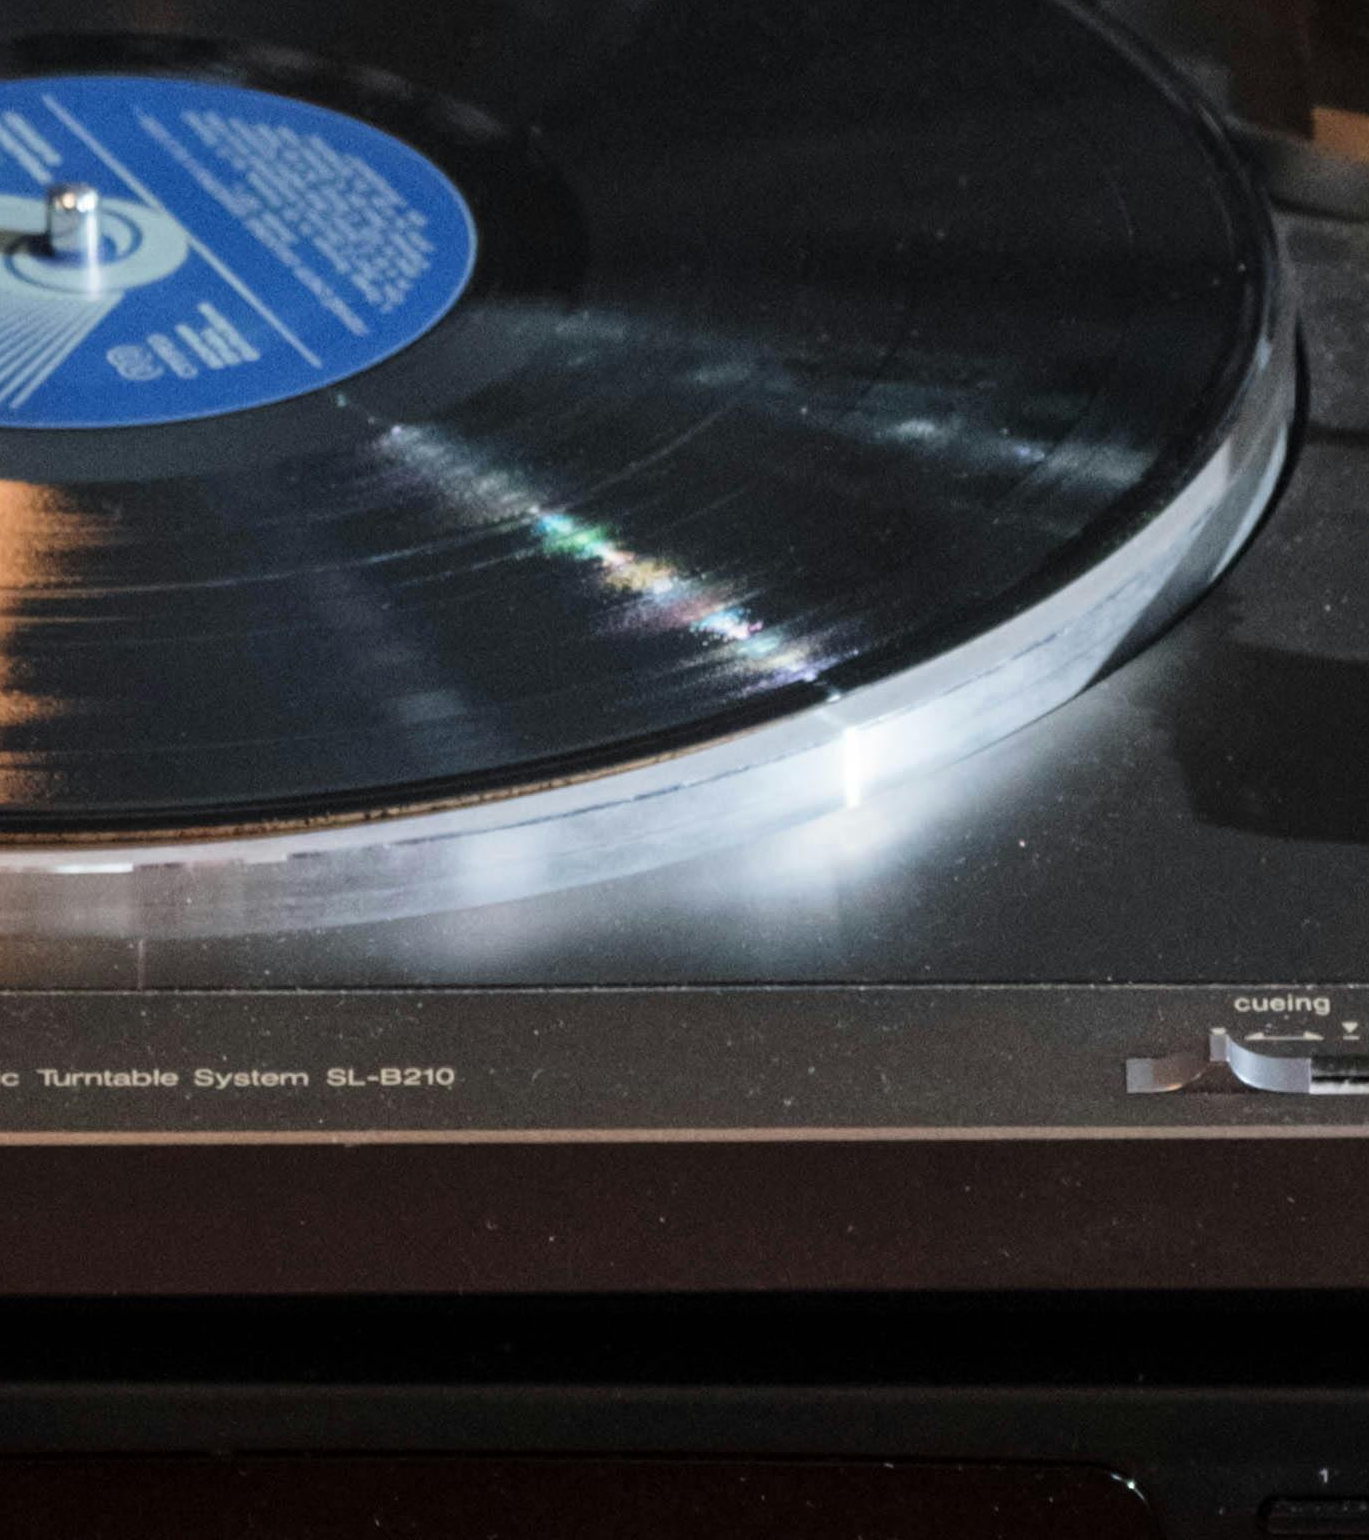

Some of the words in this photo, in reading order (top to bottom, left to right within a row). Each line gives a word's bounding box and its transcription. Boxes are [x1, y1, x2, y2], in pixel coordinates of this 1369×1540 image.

[1234, 994, 1331, 1016] cueing
[37, 1068, 178, 1087] Turntable
[195, 1068, 308, 1092] System
[327, 1067, 455, 1087] SL-B210
[1318, 1469, 1329, 1484] 1
